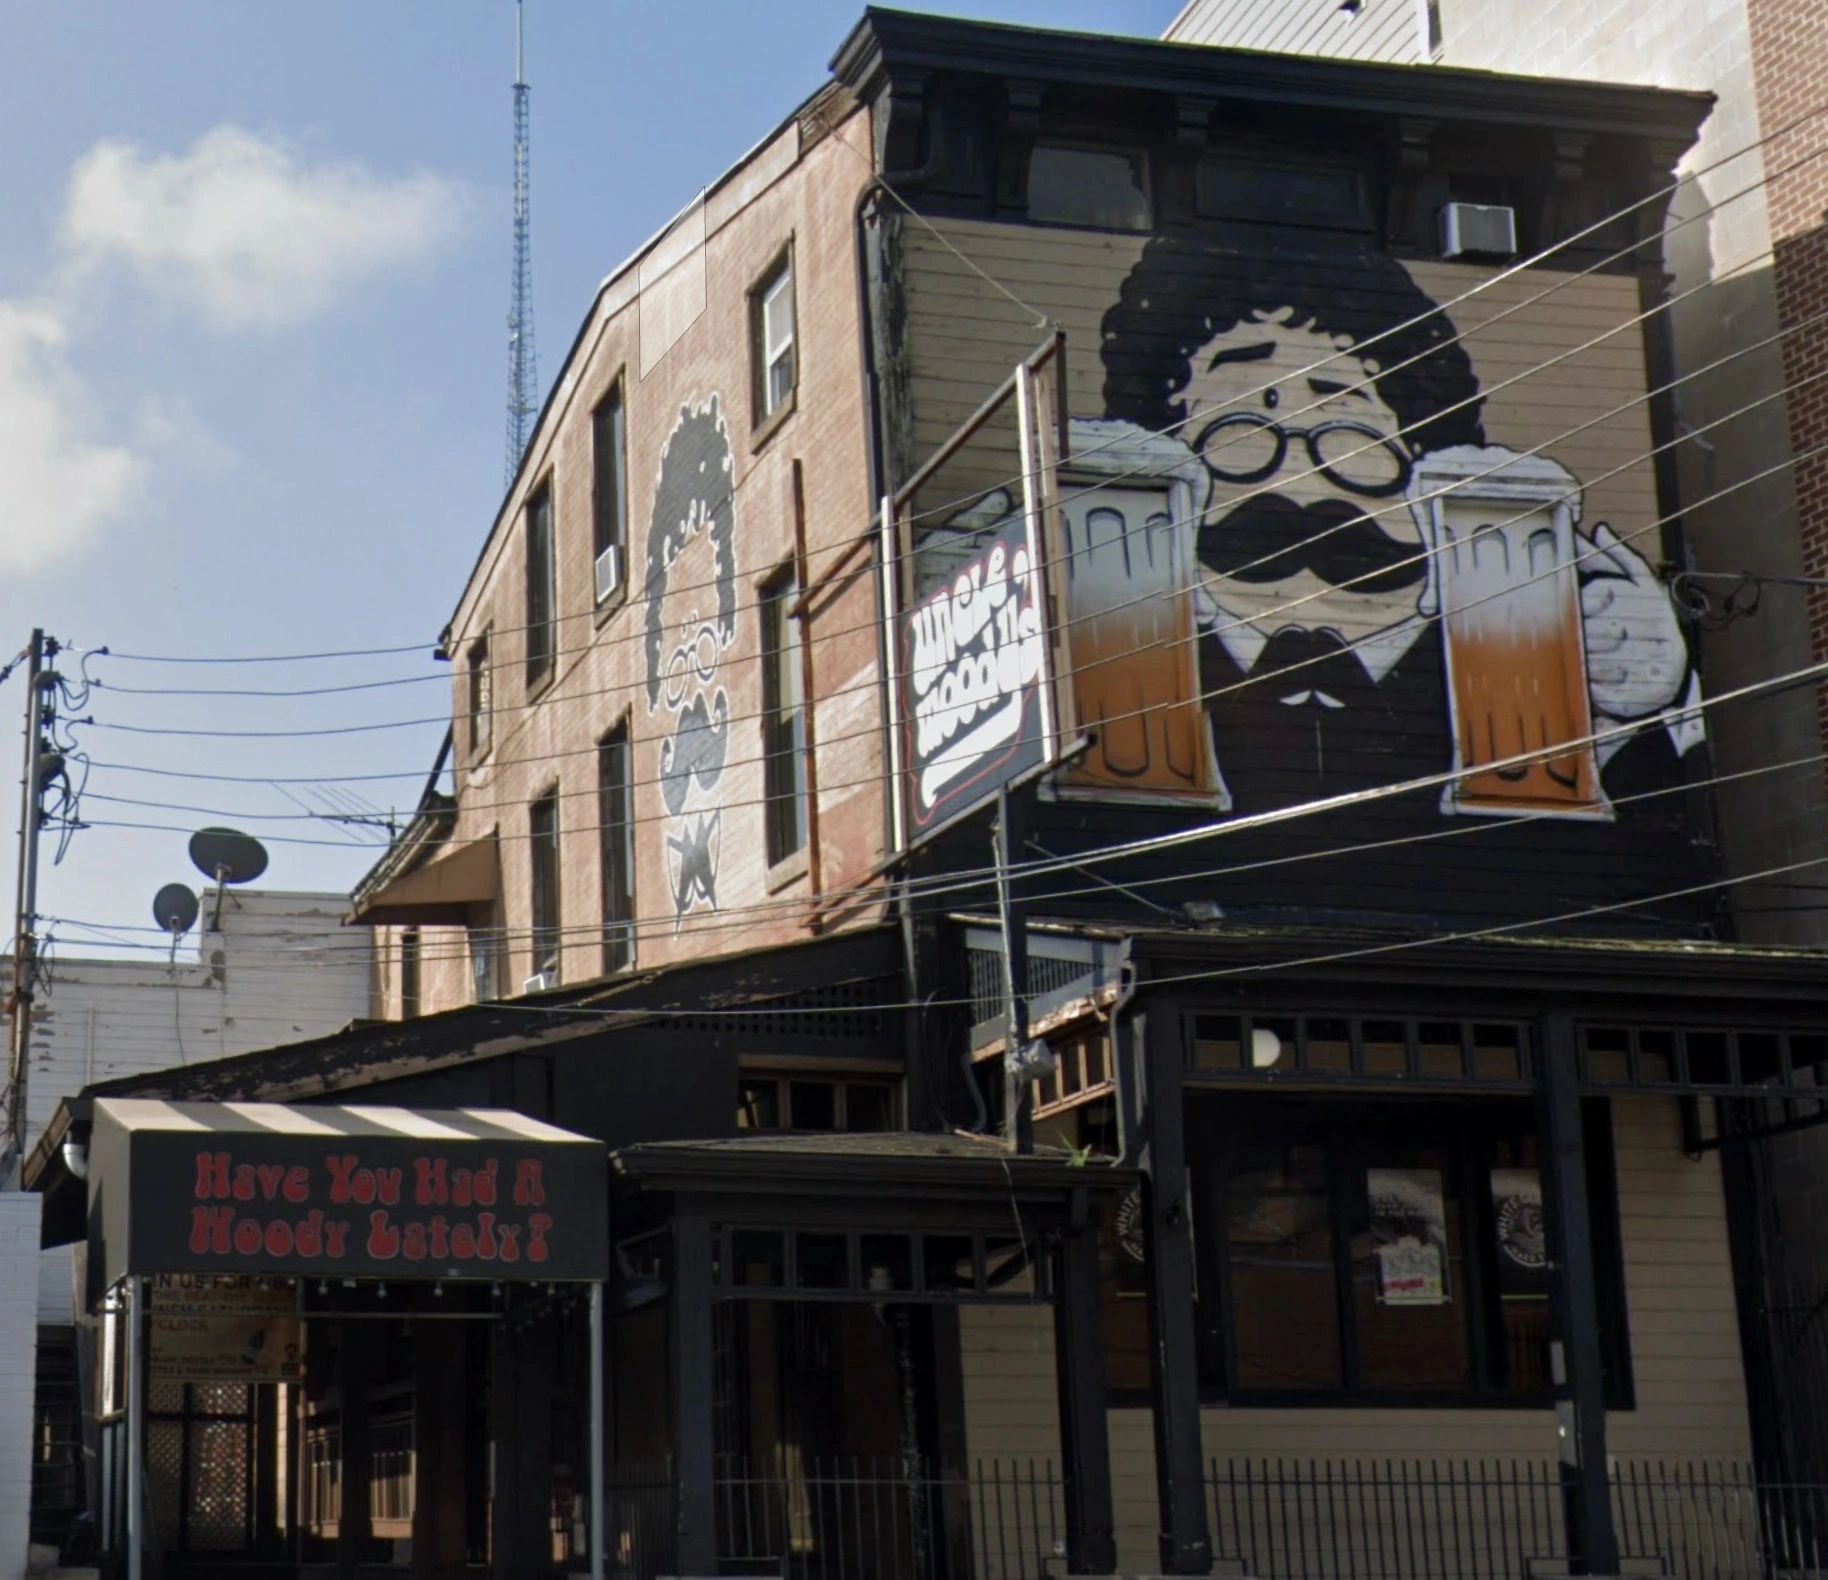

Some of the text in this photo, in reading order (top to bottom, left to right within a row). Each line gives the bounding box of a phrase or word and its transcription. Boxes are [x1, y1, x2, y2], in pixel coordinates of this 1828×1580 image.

[194, 1151, 546, 1206] Have You Had A
[367, 1209, 553, 1263] Lately?
